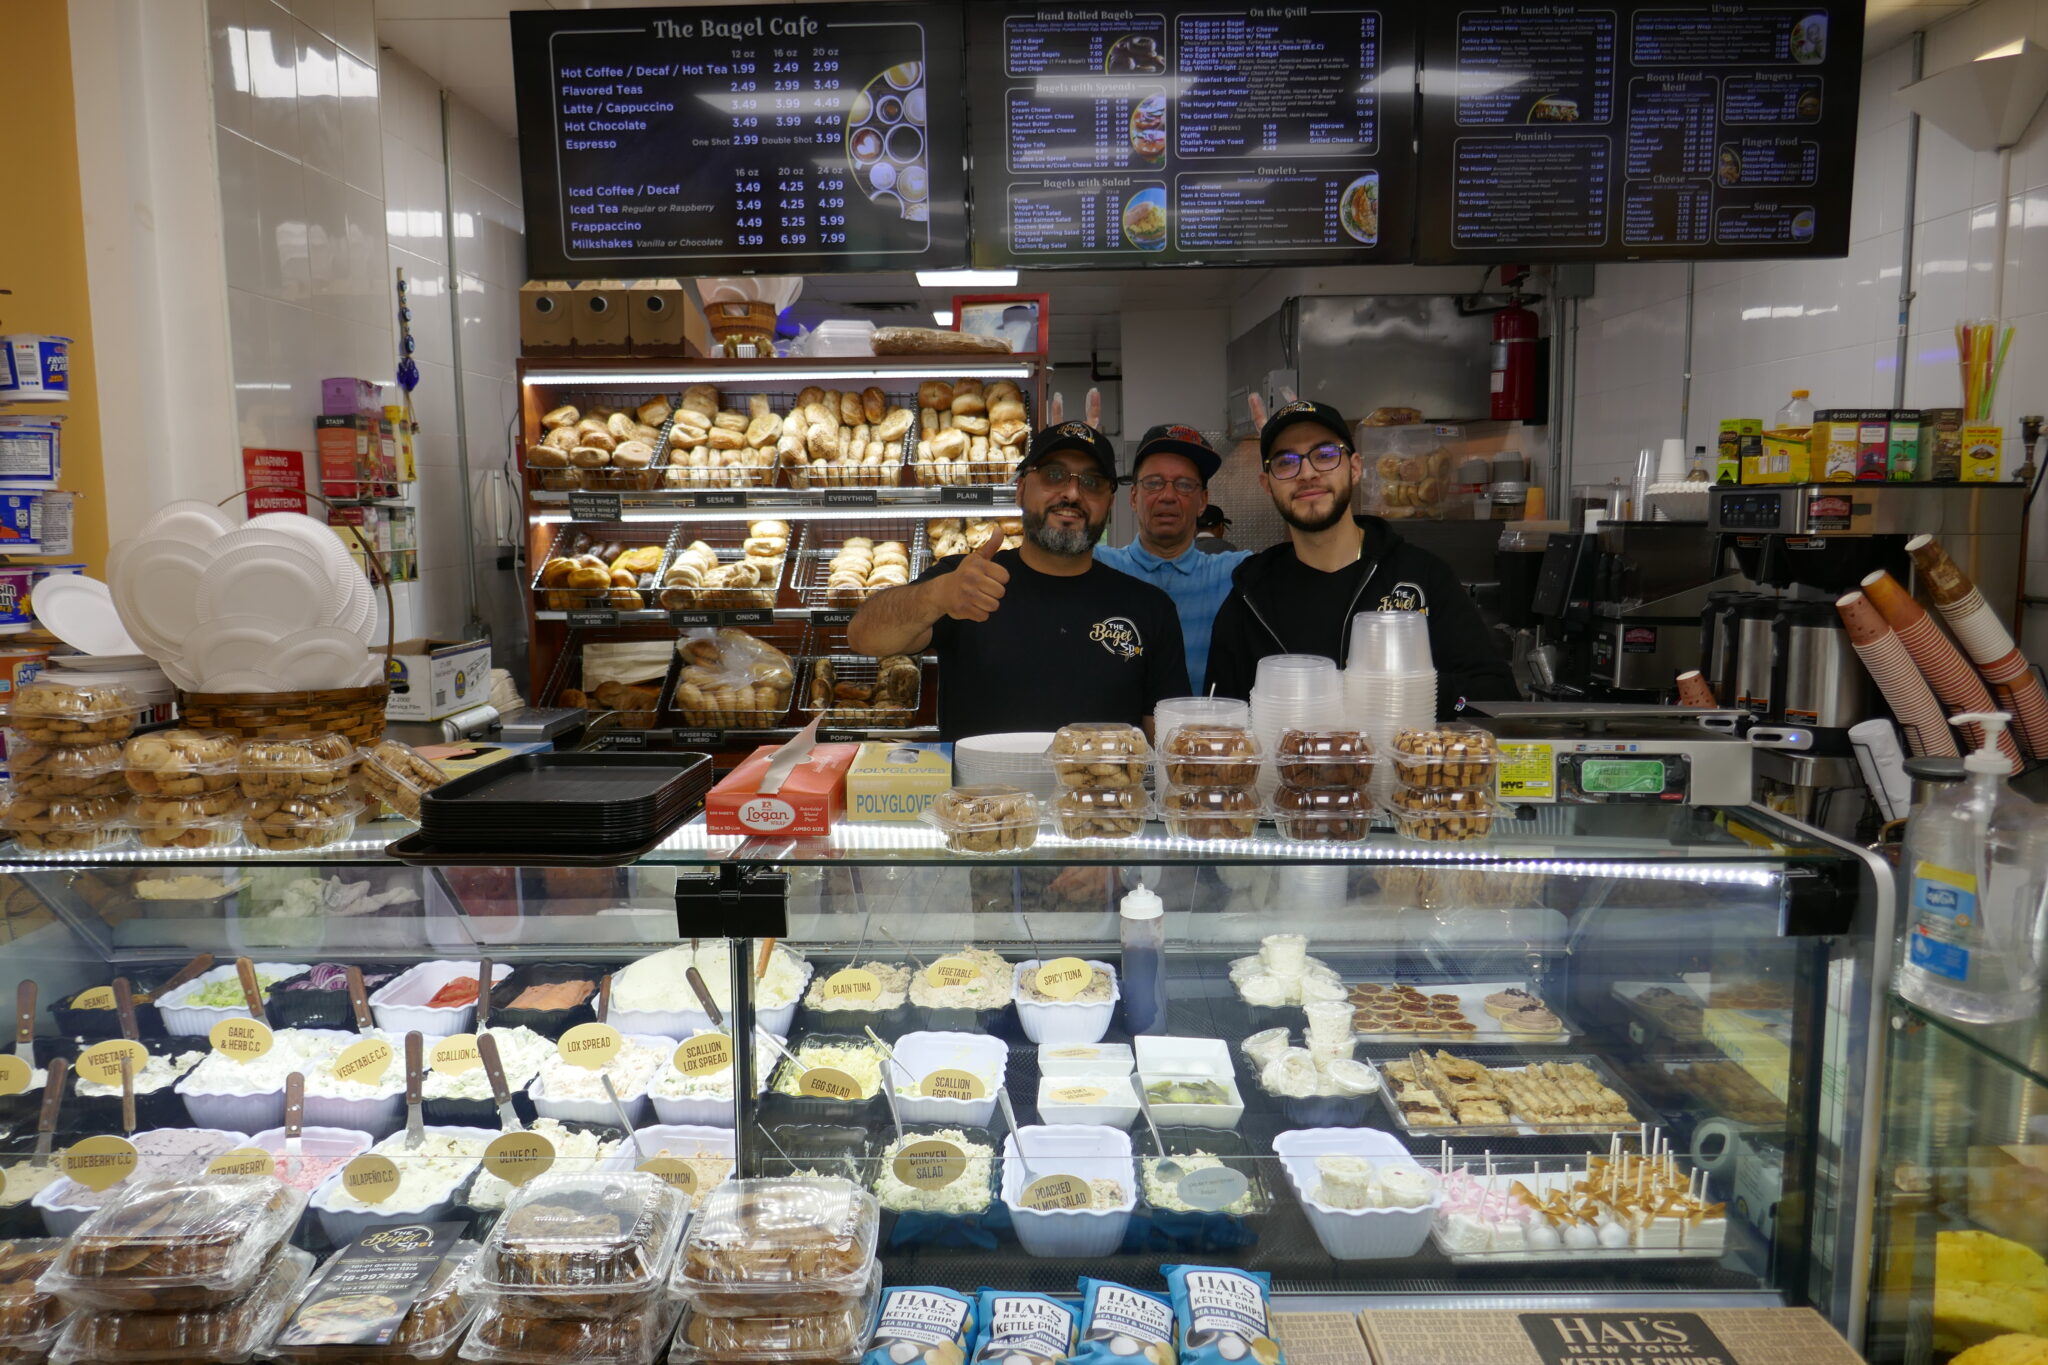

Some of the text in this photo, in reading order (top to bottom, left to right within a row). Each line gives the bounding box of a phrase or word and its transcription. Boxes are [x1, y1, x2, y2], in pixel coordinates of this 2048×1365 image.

[1037, 11, 1133, 21] Hand Rolled Bagels
[1250, 8, 1308, 19] On the Grill
[1501, 6, 1574, 16] The Lunch Spot
[653, 16, 819, 41] The Bagel Cafe
[562, 62, 838, 78] Hot Coffee Decaf Hot Tea 1.99 2.49 2.99
[562, 80, 839, 96] Flavored Teas 2.49 2.99 3.49
[564, 98, 840, 115] Latte Cappuccino 3.49 3.99 4.49
[565, 115, 840, 131] Hot Chocolate 3.49 3.99 4.49
[566, 133, 841, 152] Espresso One Shot 2.99 Double Shot 3.99
[1515, 132, 1551, 141] Paninis
[1742, 137, 1798, 147] Finger Food
[1258, 167, 1296, 175] Omelets
[1043, 177, 1130, 189] Bagels with Salad
[1653, 175, 1686, 183] Cheese
[569, 180, 843, 197] Iced Coffee Decaf 3.49 4.25 4.99
[570, 205, 594, 214] Iced
[597, 204, 618, 213] Tea
[622, 205, 655, 215] Regular
[670, 203, 714, 214] Raspberry
[737, 200, 761, 211] 3.49
[780, 199, 805, 210] 4.25
[818, 198, 844, 209] 4.99
[1754, 203, 1777, 212] Soup
[572, 216, 844, 233] Frappaccino 4.49 5.25 5.99
[573, 238, 633, 249] Milkshakes
[637, 239, 665, 248] Vanilla
[679, 238, 723, 247] Chocolate
[739, 235, 763, 246] 5.99
[781, 234, 806, 245] 6.99
[821, 233, 845, 243] 7.99
[260, 457, 288, 467] WARNING
[684, 615, 708, 623] BIALYS
[1089, 623, 1133, 646] Bagel
[1121, 642, 1143, 658] Spot
[1501, 781, 1523, 789] NYC
[746, 807, 790, 822] Logan
[938, 966, 972, 978] VEGETABLE
[1044, 969, 1082, 986] SPICY TUNA
[833, 982, 871, 994] PLAIN TUNA
[944, 977, 960, 986] TUNA
[84, 994, 109, 1008] PEANUT
[228, 1026, 254, 1039] GARLIC
[229, 1041, 261, 1052] HERB C.C
[567, 1037, 611, 1052] LOX SPREAD
[687, 1041, 722, 1058] SCALLION
[88, 1049, 134, 1066] VEGETABLE
[336, 1046, 388, 1078] VEGETABLE C.C
[437, 1050, 470, 1062] SCALLION
[684, 1052, 728, 1072] LOX SPREAD
[102, 1065, 123, 1076] TOFU
[811, 1078, 850, 1098] EGG SALAD
[935, 1077, 970, 1088] SCALLION
[67, 1152, 132, 1169] BLUEBERRY C.C
[500, 1149, 538, 1164] OLIVE C.C
[909, 1150, 947, 1163] CHICKEN
[349, 1170, 393, 1187] JALAPEÑO C.C
[661, 1173, 690, 1184] SALMON
[916, 1167, 944, 1179] SALAD
[1035, 1181, 1071, 1200] POACHED
[1061, 1192, 1087, 1208] SALAD
[1198, 1276, 1255, 1299] HAL'S
[899, 1294, 957, 1312] HAL'S
[1109, 1291, 1165, 1317] HAL'S
[1227, 1292, 1254, 1304] YORK
[1004, 1302, 1062, 1323] HAL'S
[1195, 1297, 1263, 1320] KETTLE CHIPS
[886, 1311, 958, 1328] KETTLE CHIPS
[1552, 1317, 1688, 1344] HAL'S
[1568, 1345, 1694, 1353] NEW YORK
